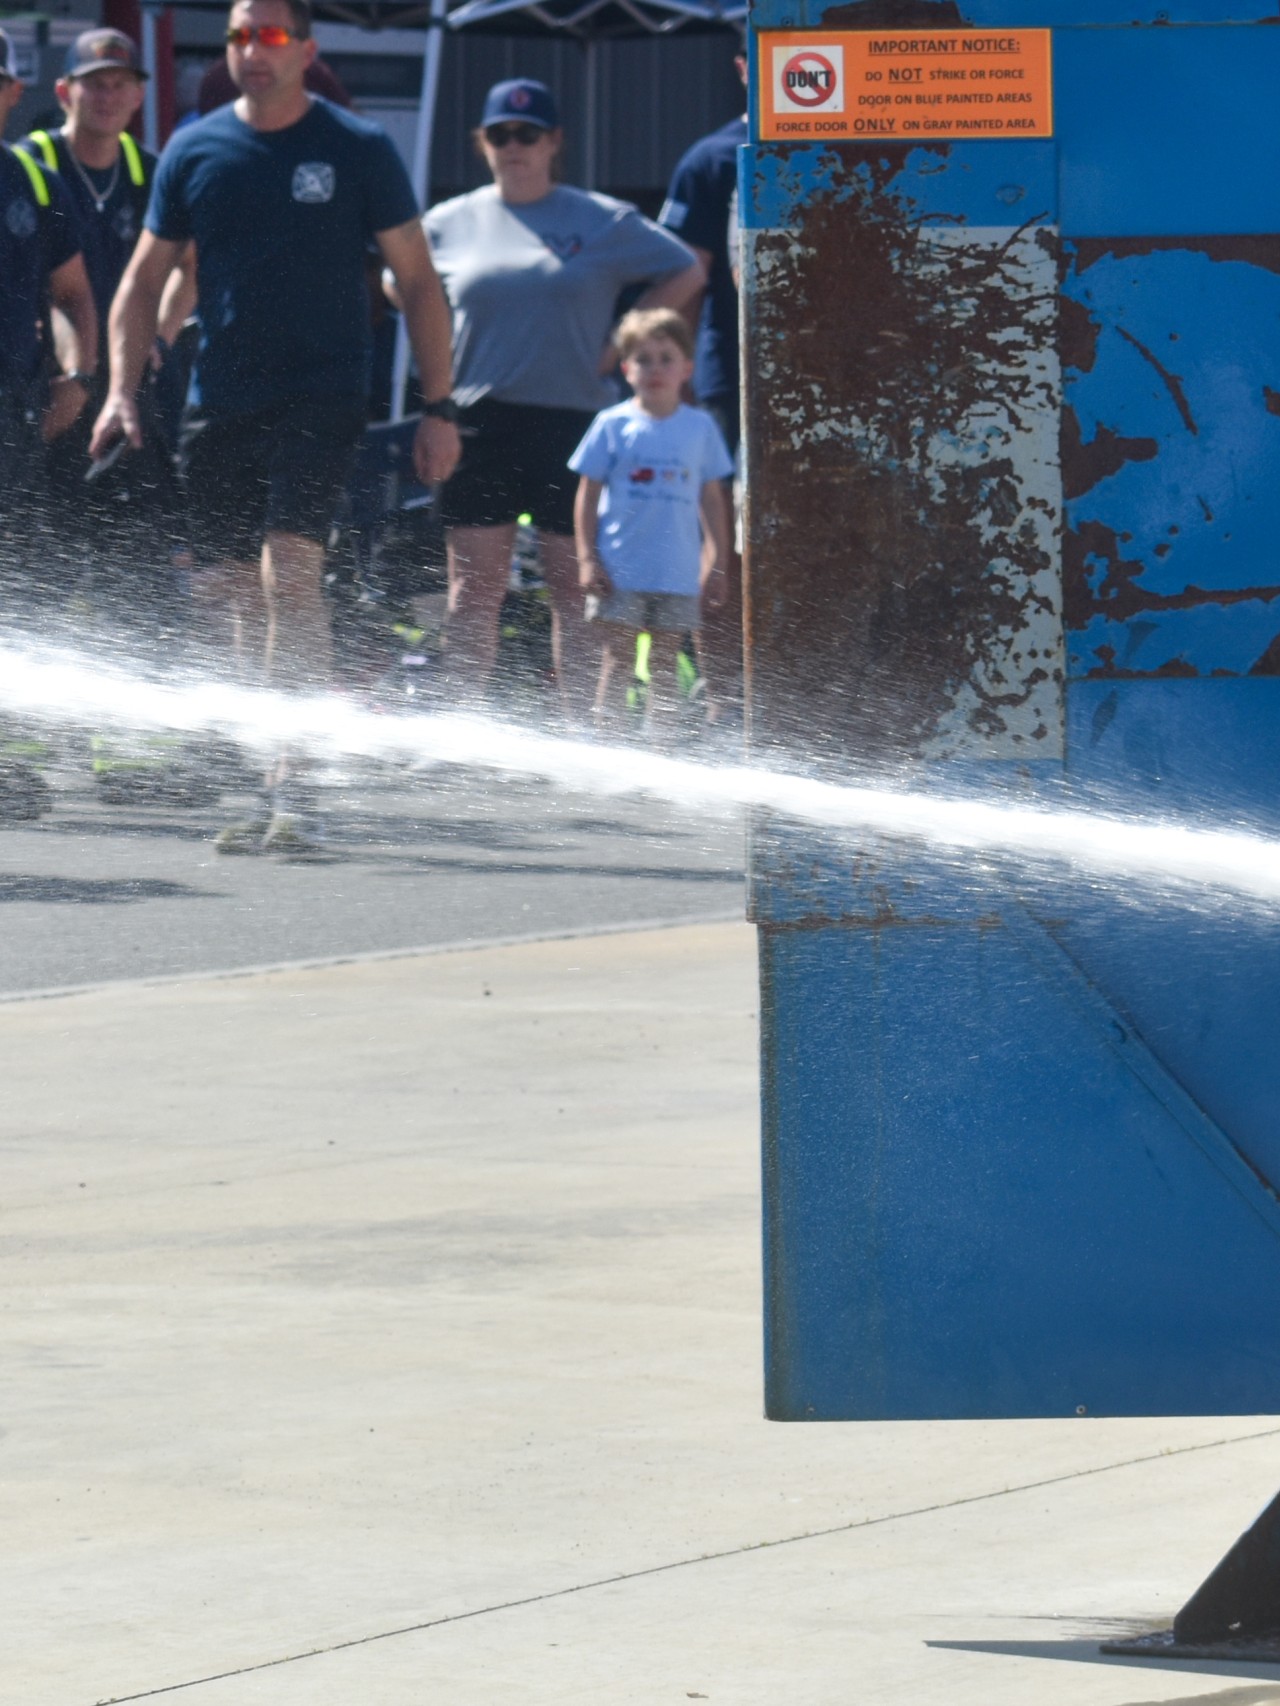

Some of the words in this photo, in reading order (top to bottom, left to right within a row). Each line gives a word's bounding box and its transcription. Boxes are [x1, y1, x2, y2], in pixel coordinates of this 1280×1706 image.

[868, 39, 957, 54] IMPORTANT
[962, 38, 1020, 53] NOTICE:
[786, 71, 831, 88] DON'T
[864, 71, 883, 81] DO
[888, 68, 923, 83] NOT
[929, 70, 967, 80] STRIKE
[970, 70, 986, 80] OR
[988, 69, 1024, 79] FORCE
[858, 96, 892, 106] DOOR
[894, 95, 912, 104] ON
[915, 94, 943, 104] BLUE
[946, 94, 994, 104] PAINTED
[996, 93, 1032, 102] AREAS
[776, 122, 811, 132] FORCE
[814, 122, 848, 132] DOOR
[854, 118, 896, 134] ONLY
[902, 120, 920, 130] ON
[923, 120, 952, 130] GRAY
[956, 120, 1004, 129] PAINTED
[1006, 119, 1036, 128] AREA
